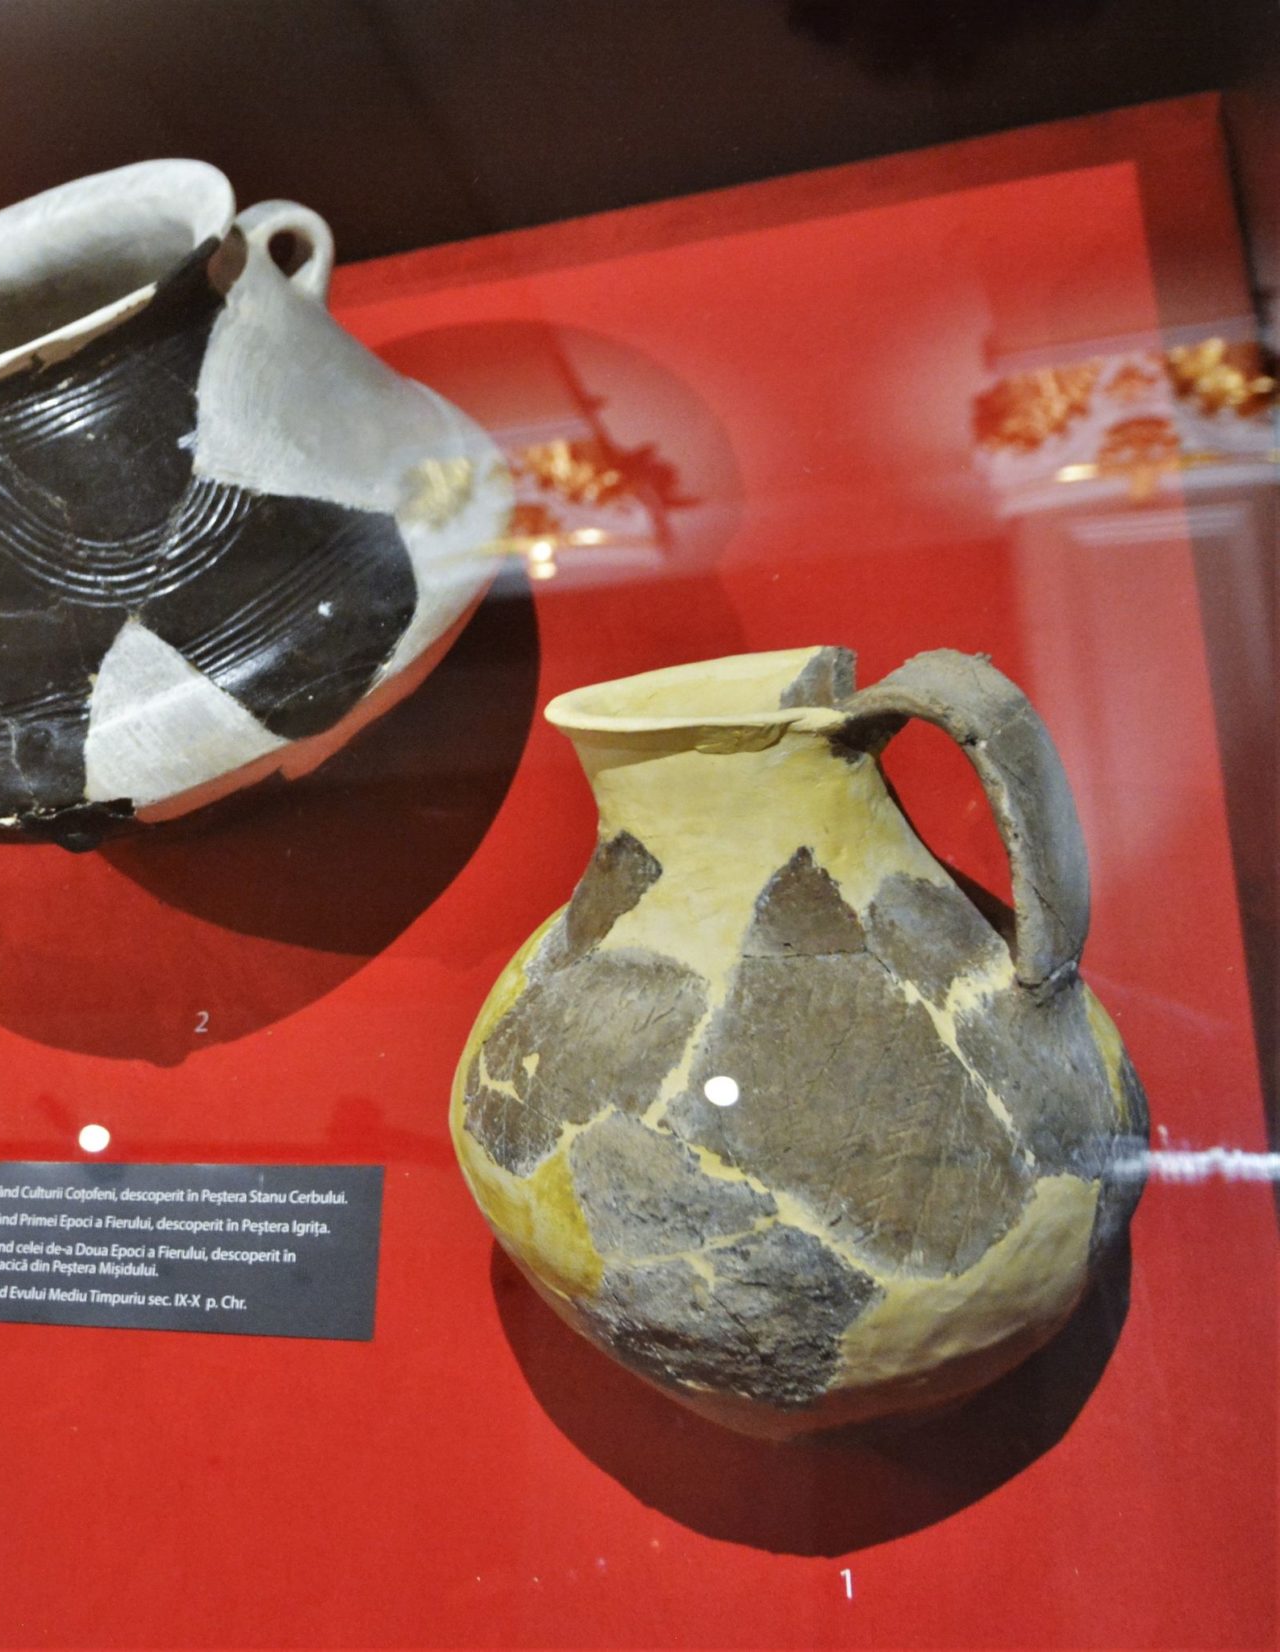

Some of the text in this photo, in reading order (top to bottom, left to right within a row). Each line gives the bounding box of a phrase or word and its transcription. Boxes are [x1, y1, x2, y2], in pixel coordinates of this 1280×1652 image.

[193, 1010, 209, 1034] 2
[21, 1186, 63, 1200] Culturii
[121, 1188, 184, 1205] descoperit
[187, 1188, 199, 1201] în
[249, 1190, 287, 1204] Stanu
[289, 1190, 348, 1205] Cerbului.
[19, 1213, 57, 1227] Primei
[59, 1215, 93, 1230] Epoci
[94, 1218, 103, 1229] a
[105, 1216, 154, 1231] Fierului,
[156, 1217, 224, 1234] descoperit
[226, 1218, 239, 1232] în
[16, 1241, 44, 1254] celei
[45, 1242, 73, 1256] de-a
[75, 1243, 109, 1257] Doua
[111, 1244, 145, 1260] Epoci
[147, 1247, 156, 1258] a
[158, 1245, 208, 1261] Fierului,
[211, 1247, 280, 1264] descoperit
[283, 1248, 296, 1262] în
[30, 1260, 50, 1272] din
[9, 1286, 46, 1300] Evului
[48, 1288, 87, 1302] Mediu
[90, 1290, 146, 1307] Timpuriu
[148, 1294, 172, 1307] sec.
[174, 1293, 201, 1308] IX-X
[205, 1298, 219, 1311] p.
[221, 1295, 248, 1310] Chr.
[839, 1567, 853, 1600] 1
